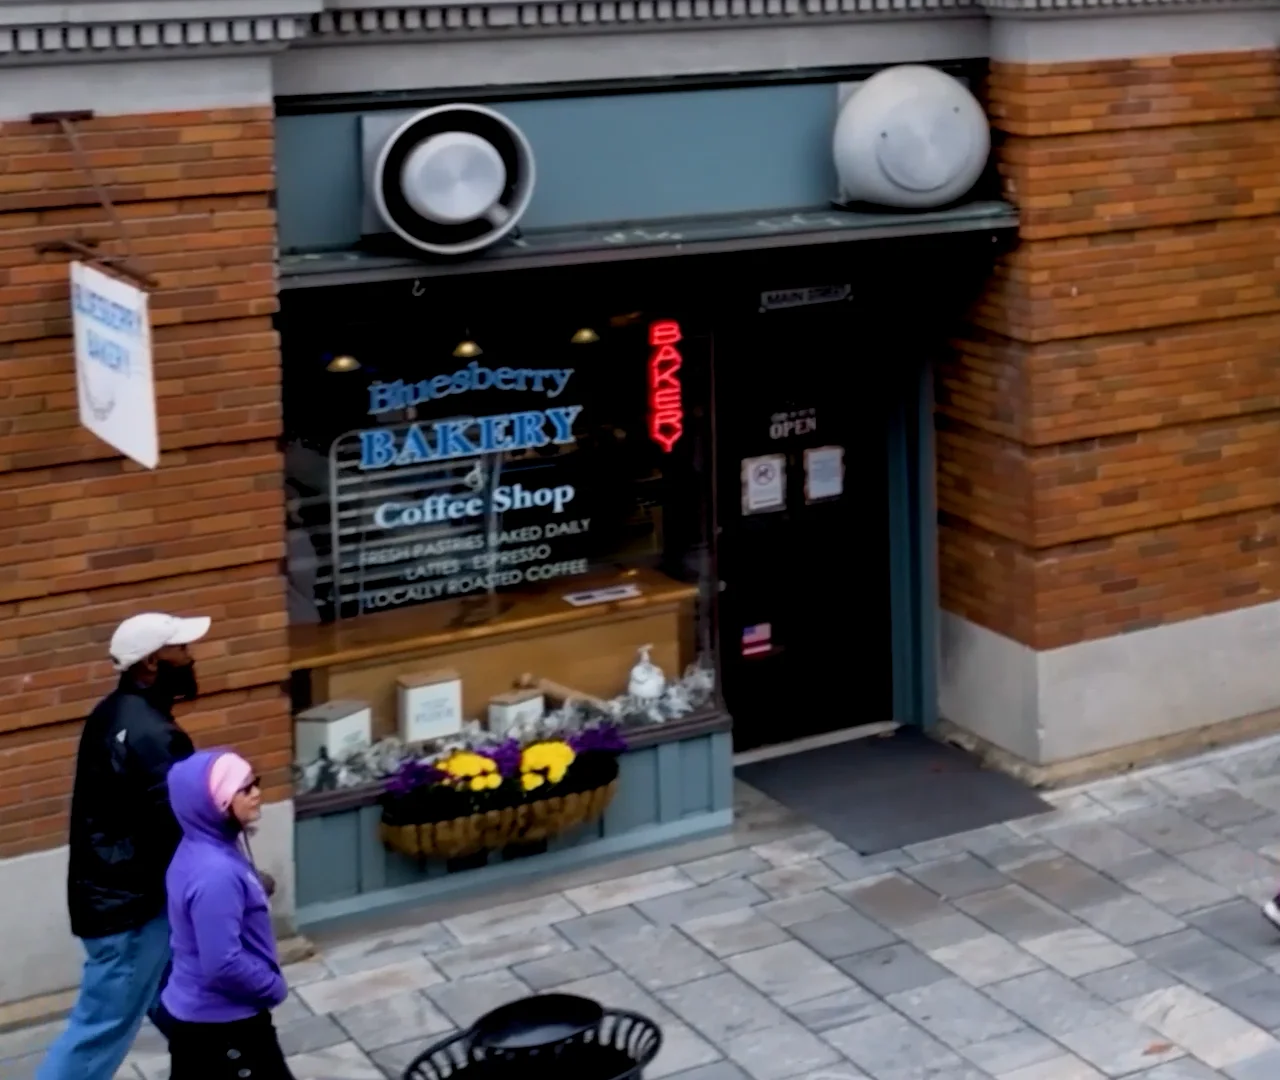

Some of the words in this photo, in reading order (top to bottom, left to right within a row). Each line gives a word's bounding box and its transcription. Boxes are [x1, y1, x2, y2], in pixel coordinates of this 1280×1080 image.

[368, 360, 576, 415] Bluesberry
[650, 319, 683, 453] BAKERY
[358, 404, 584, 471] BAKERY
[769, 417, 817, 440] OPEN
[374, 493, 484, 529] Coffee
[491, 482, 576, 513] Shop
[359, 548, 410, 566] FRESH
[412, 534, 485, 557] PASTRIES
[488, 523, 542, 547] BAKED
[544, 518, 592, 537] DAILY
[405, 559, 461, 581] LATTES
[472, 543, 552, 569] ESPRESSO
[366, 581, 445, 609] LOCALLY
[447, 569, 523, 596] ROASTED
[525, 558, 589, 583] COFFEE
